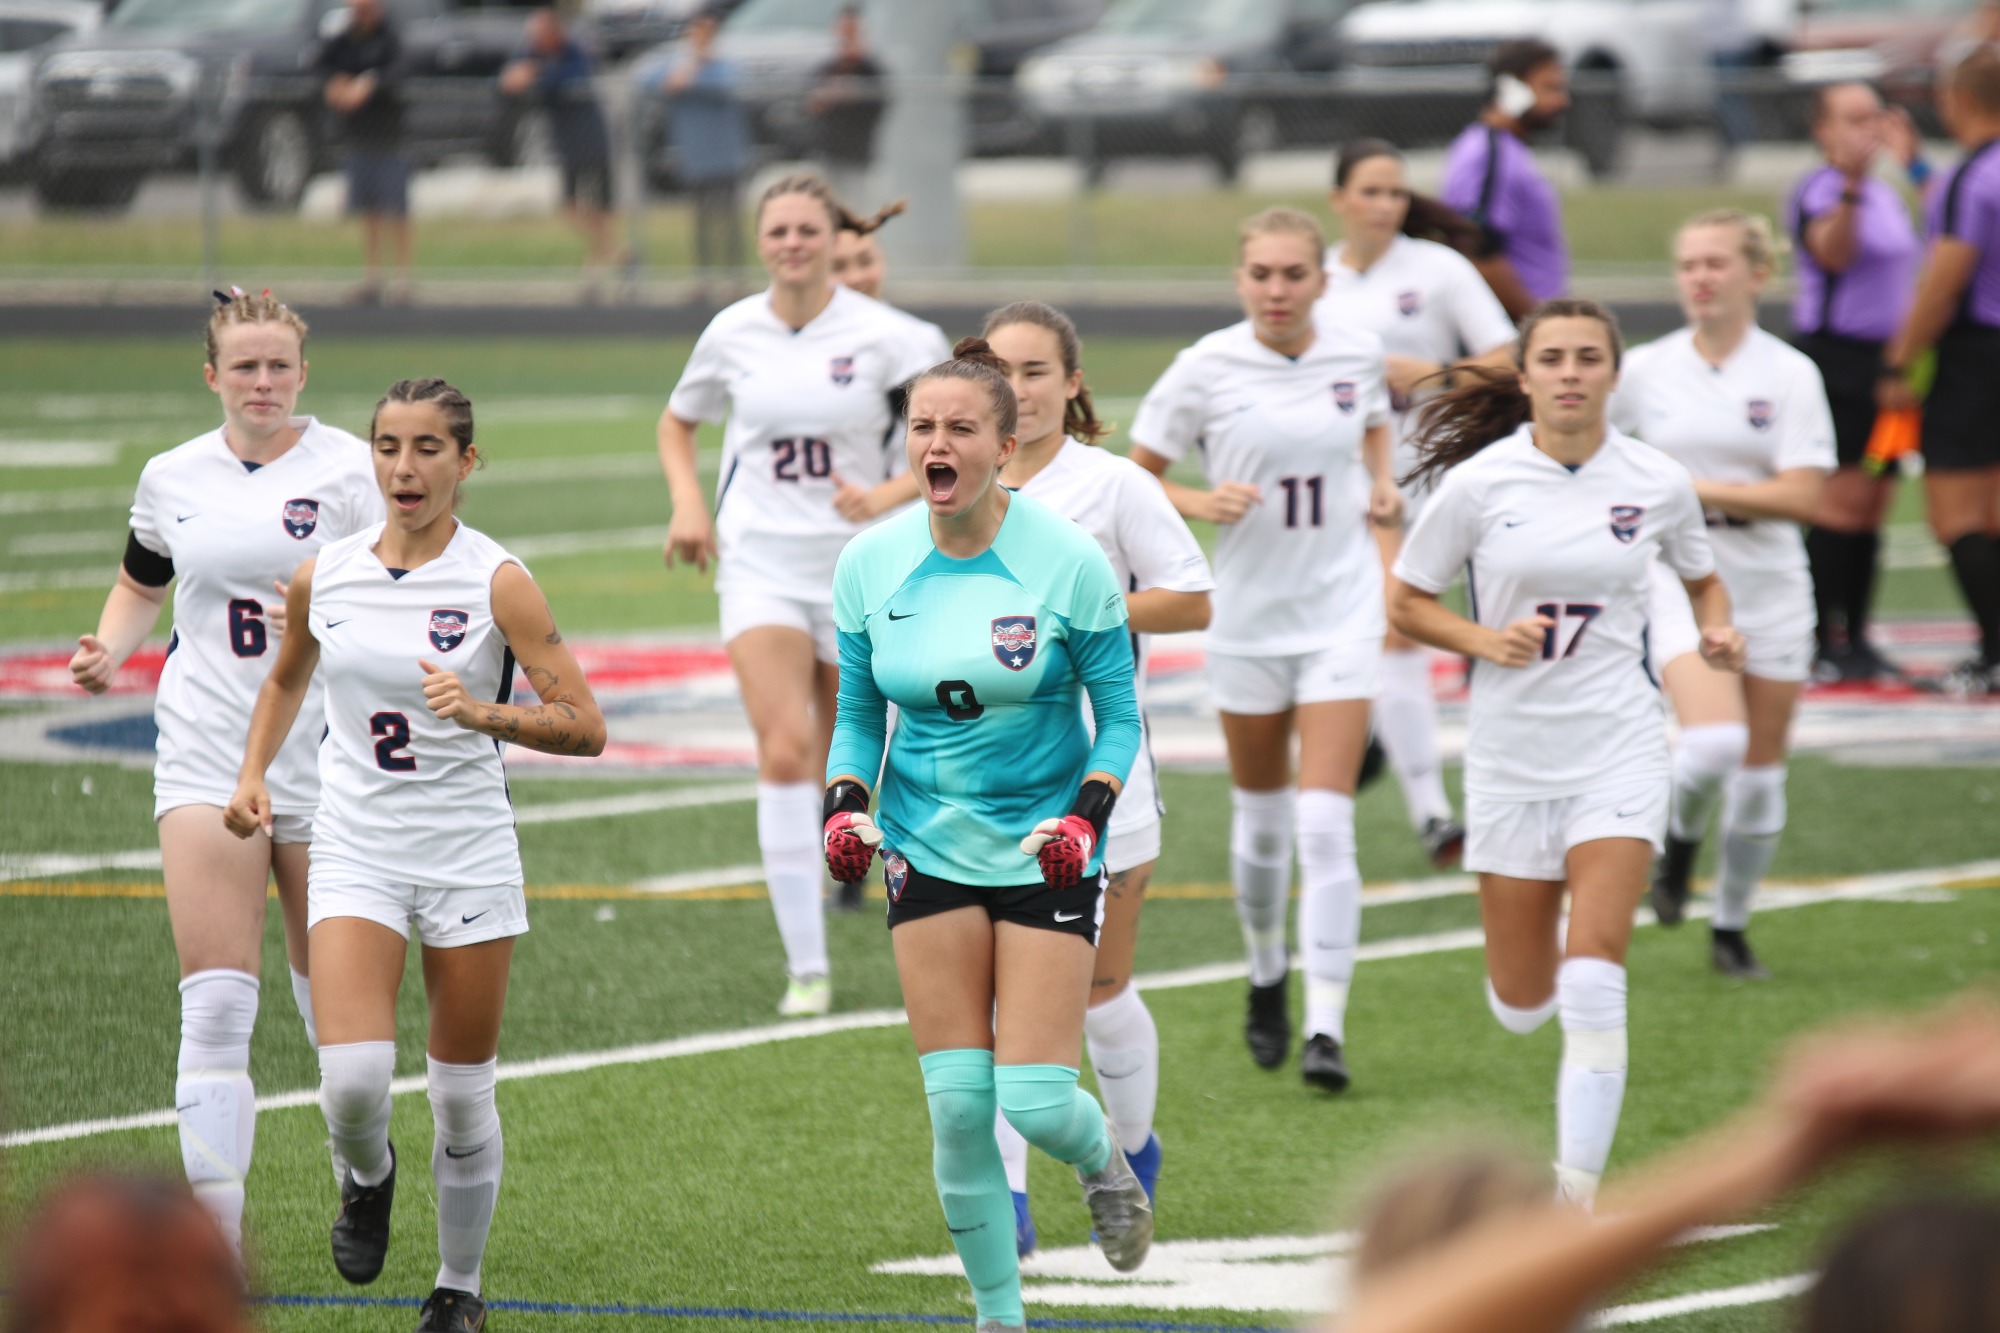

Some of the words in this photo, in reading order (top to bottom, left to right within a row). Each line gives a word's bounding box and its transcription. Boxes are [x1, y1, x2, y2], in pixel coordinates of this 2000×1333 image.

[771, 437, 832, 481] 20
[1279, 475, 1325, 529] 11
[228, 598, 267, 658] 6
[1535, 603, 1605, 661] 17
[935, 679, 985, 722] 0
[369, 711, 417, 772] 2
